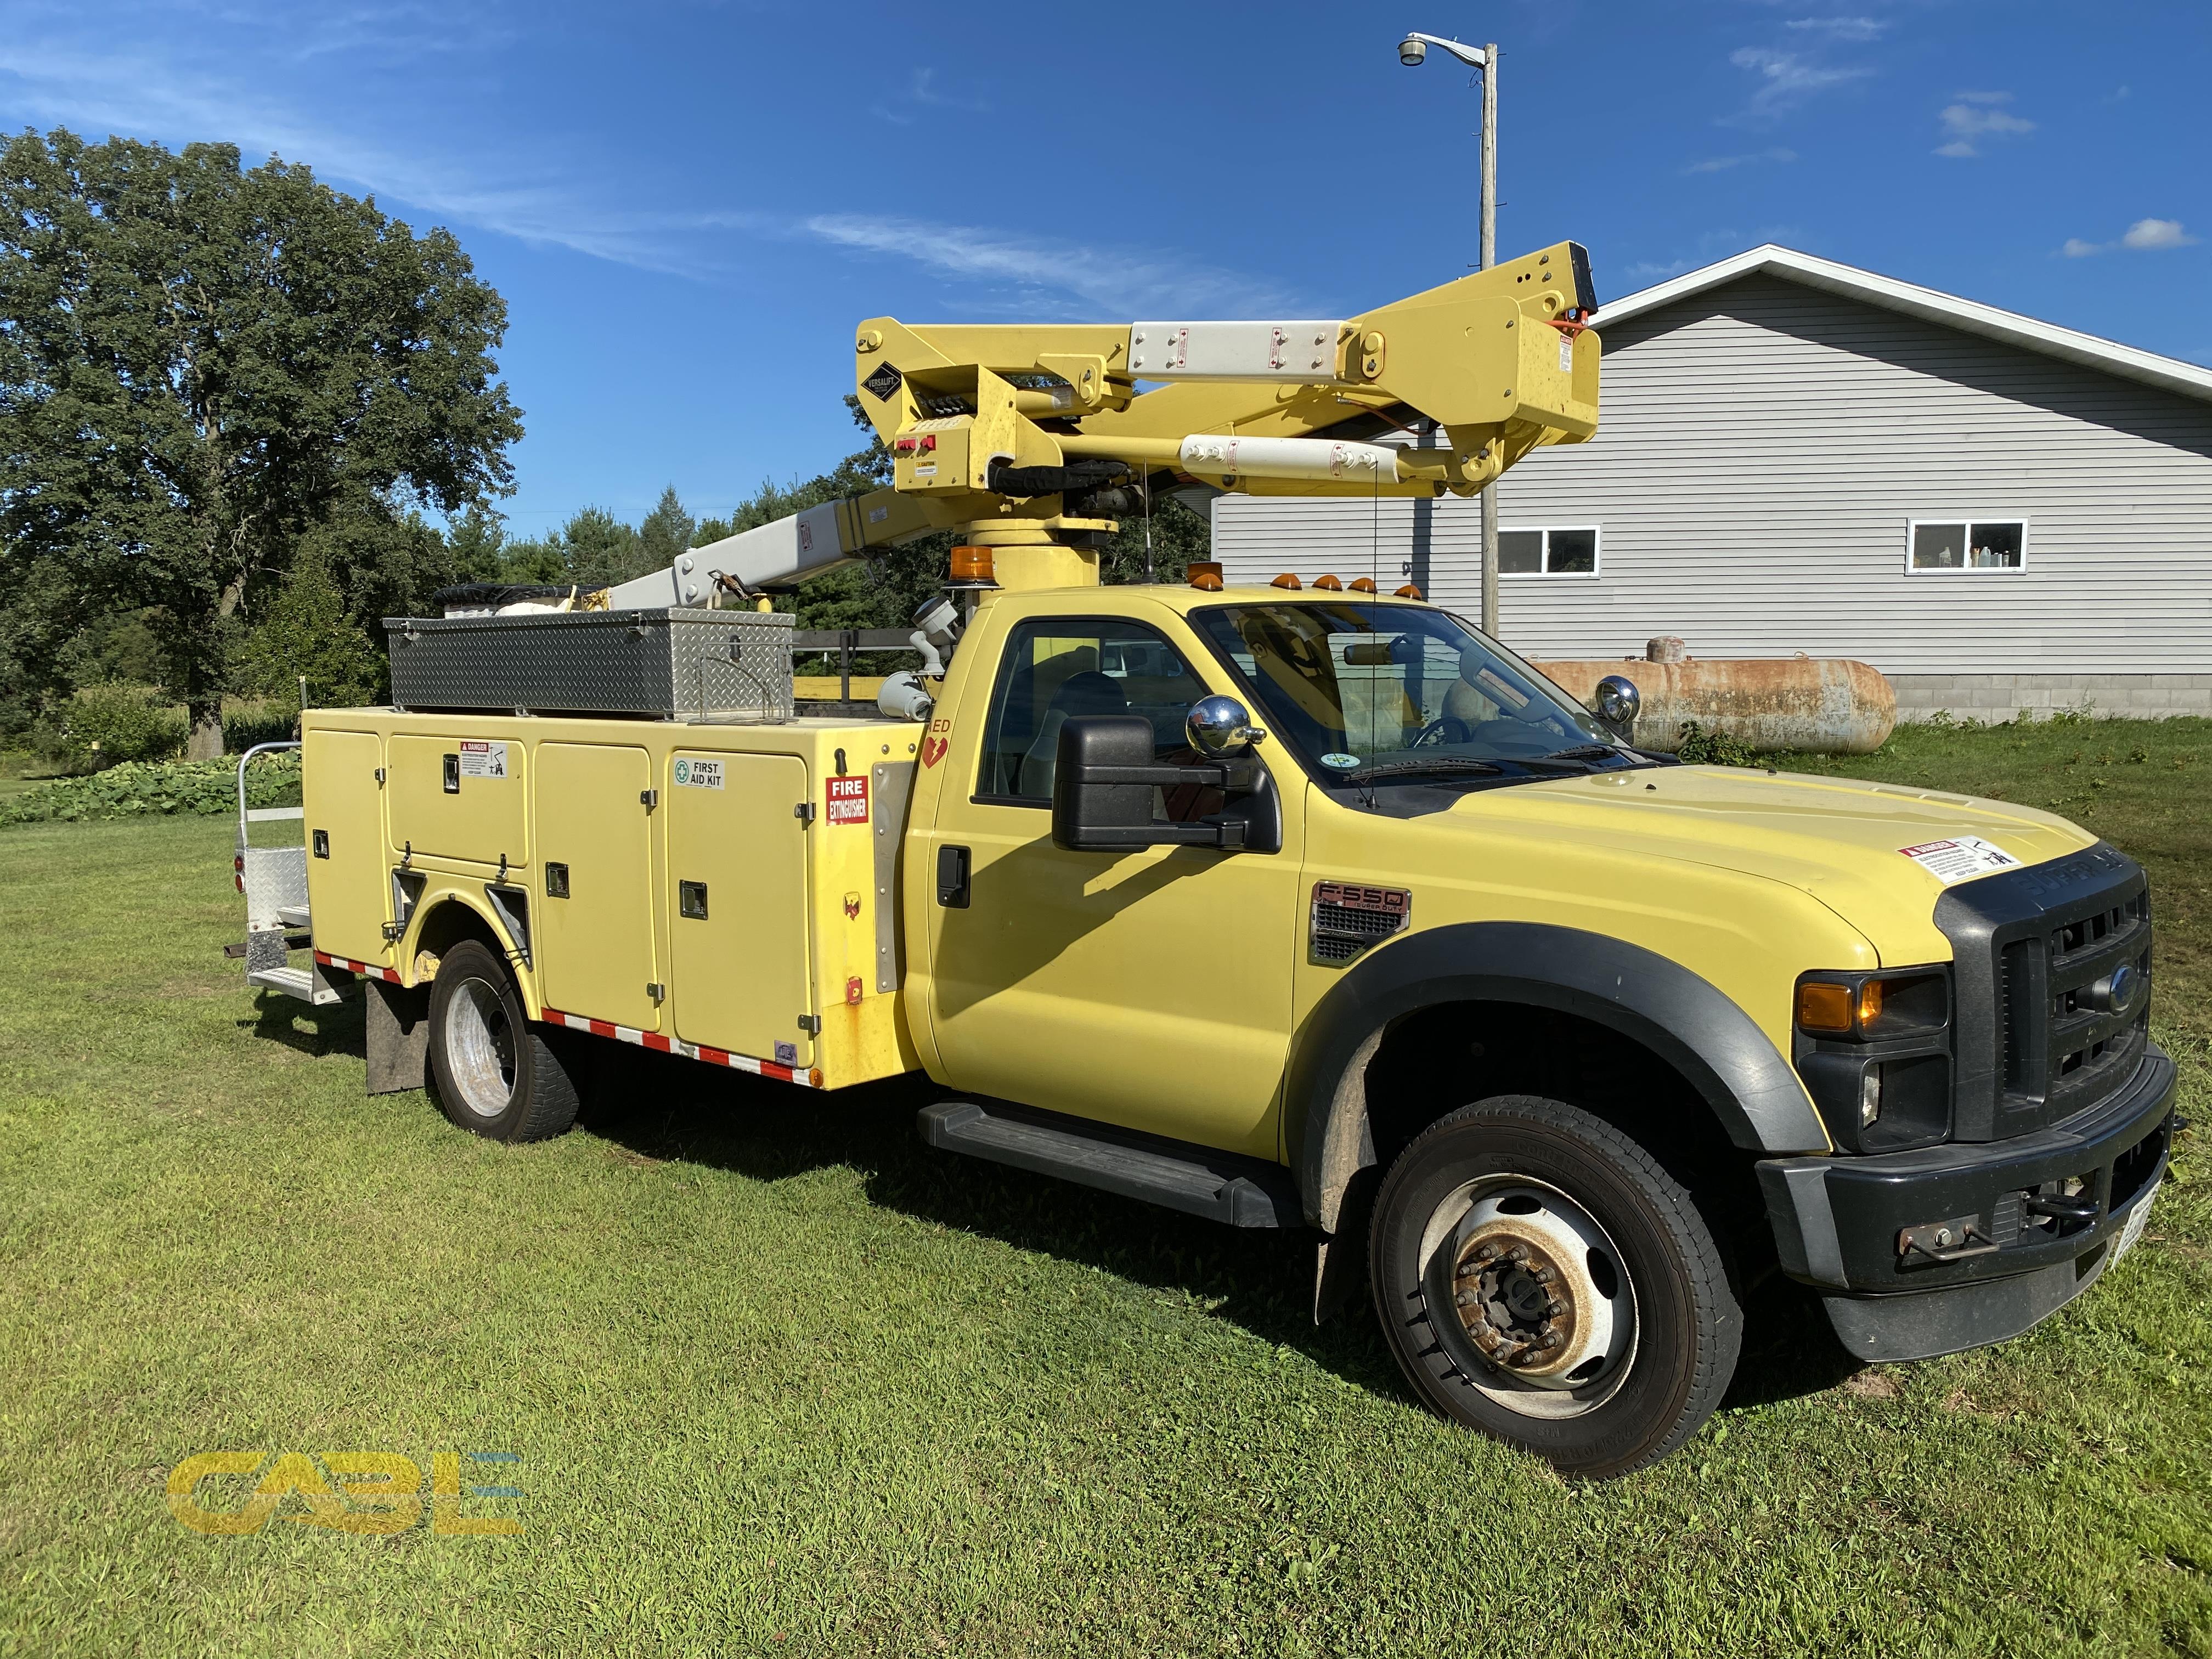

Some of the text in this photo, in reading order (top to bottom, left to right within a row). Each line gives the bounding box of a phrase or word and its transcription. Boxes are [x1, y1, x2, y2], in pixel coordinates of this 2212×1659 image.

[868, 377, 894, 387] VERSALIFT
[694, 762, 718, 774] FIRST
[690, 774, 721, 786] AID KIT
[832, 780, 862, 796] FIRE
[830, 798, 866, 820] EXTINGUISHER
[1913, 842, 1955, 853] DANGER
[1319, 884, 1403, 906] F-550
